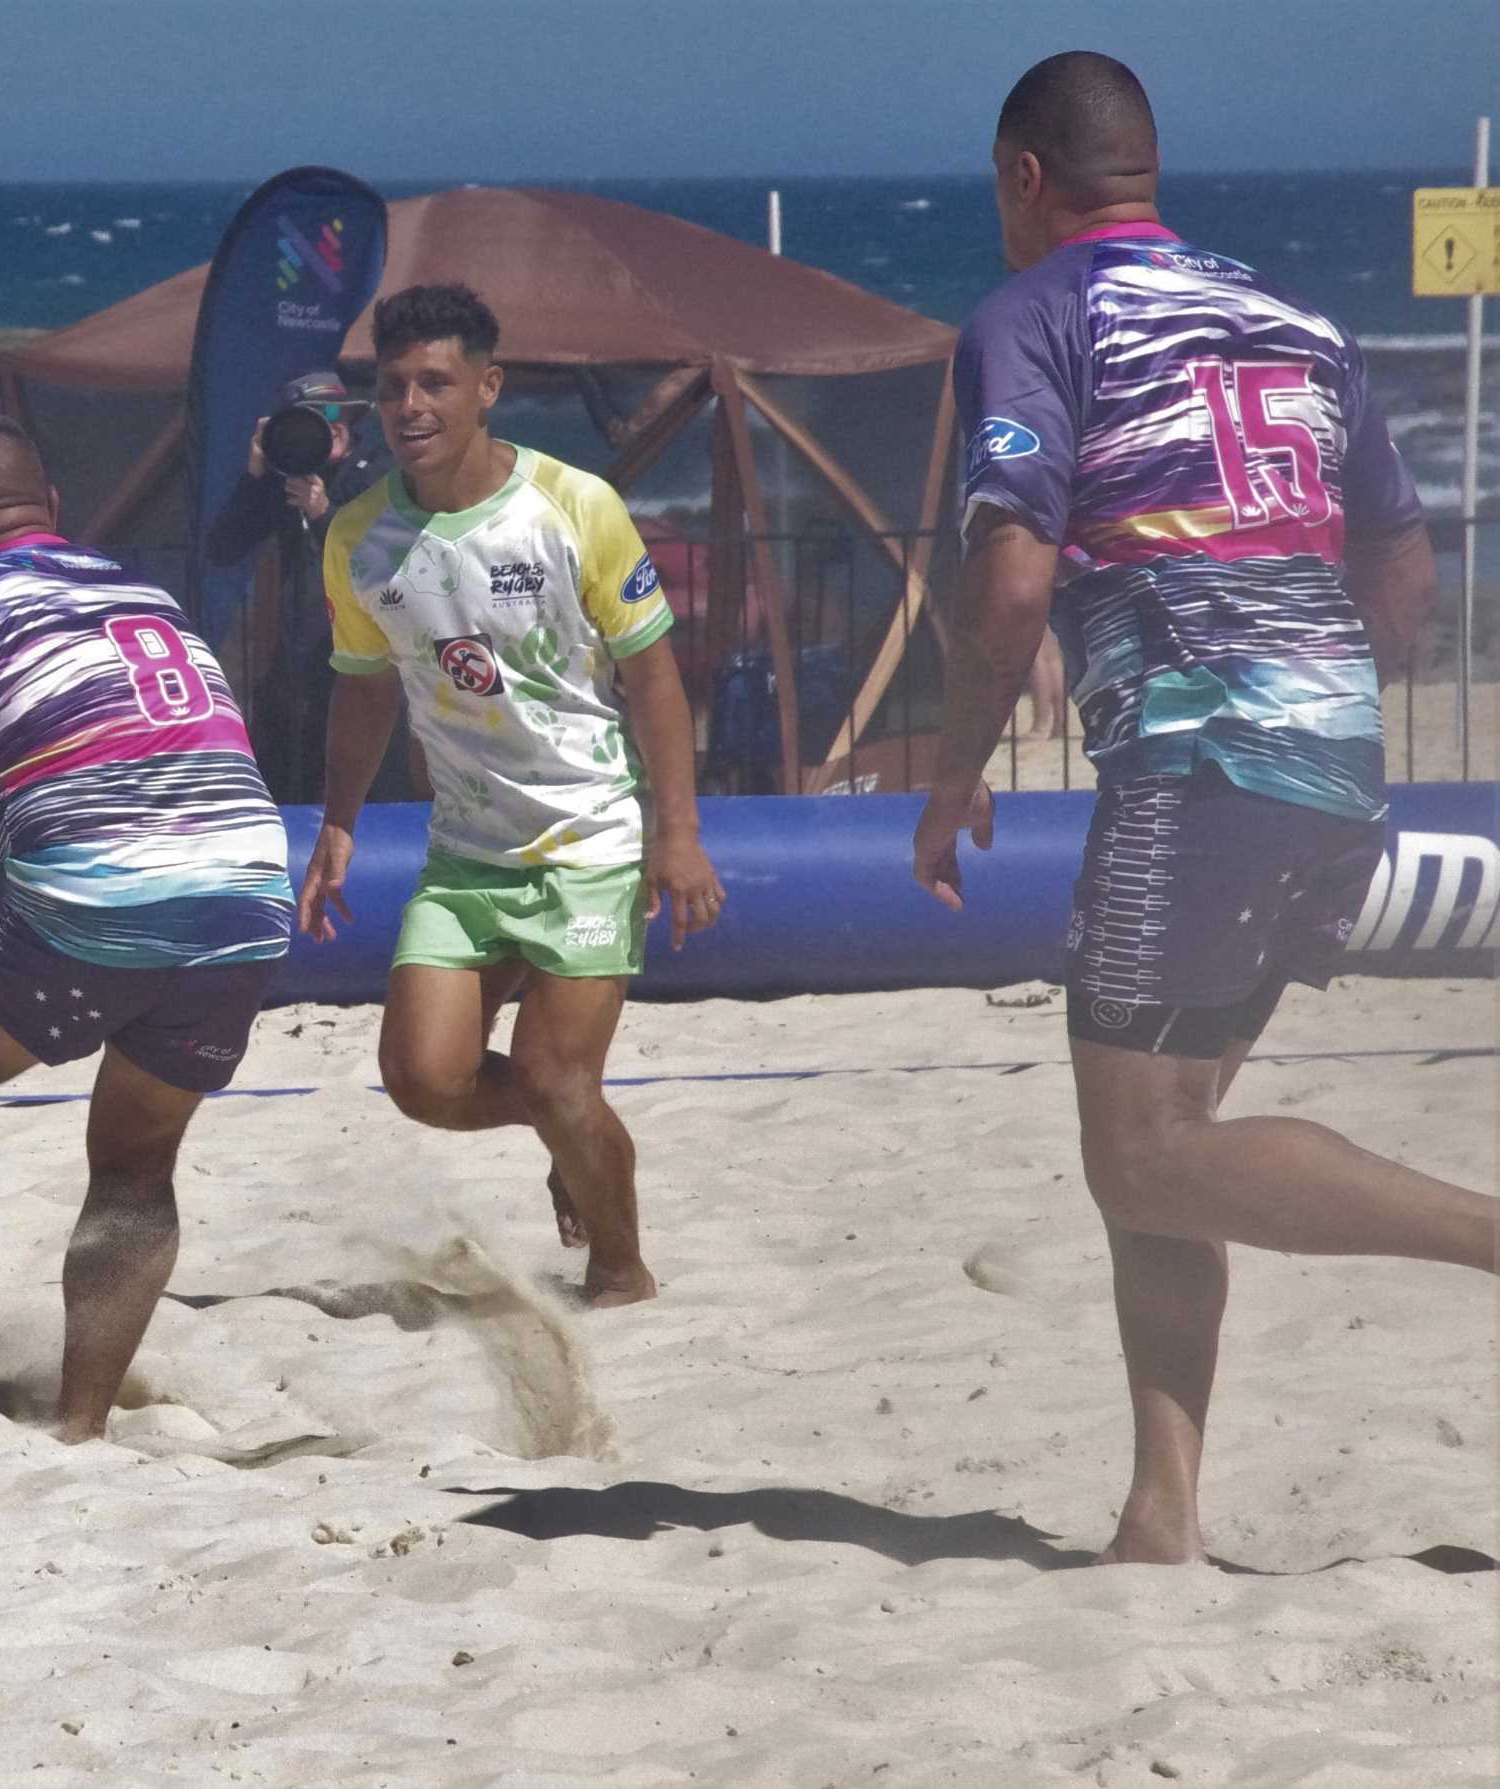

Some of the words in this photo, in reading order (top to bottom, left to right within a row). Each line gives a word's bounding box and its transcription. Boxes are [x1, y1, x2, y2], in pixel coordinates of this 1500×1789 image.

[1173, 254, 1203, 271] City
[1186, 358, 1332, 529] 15
[490, 576, 545, 595] RUGBY
[105, 614, 214, 726] 8
[564, 929, 617, 948] RUGBY
